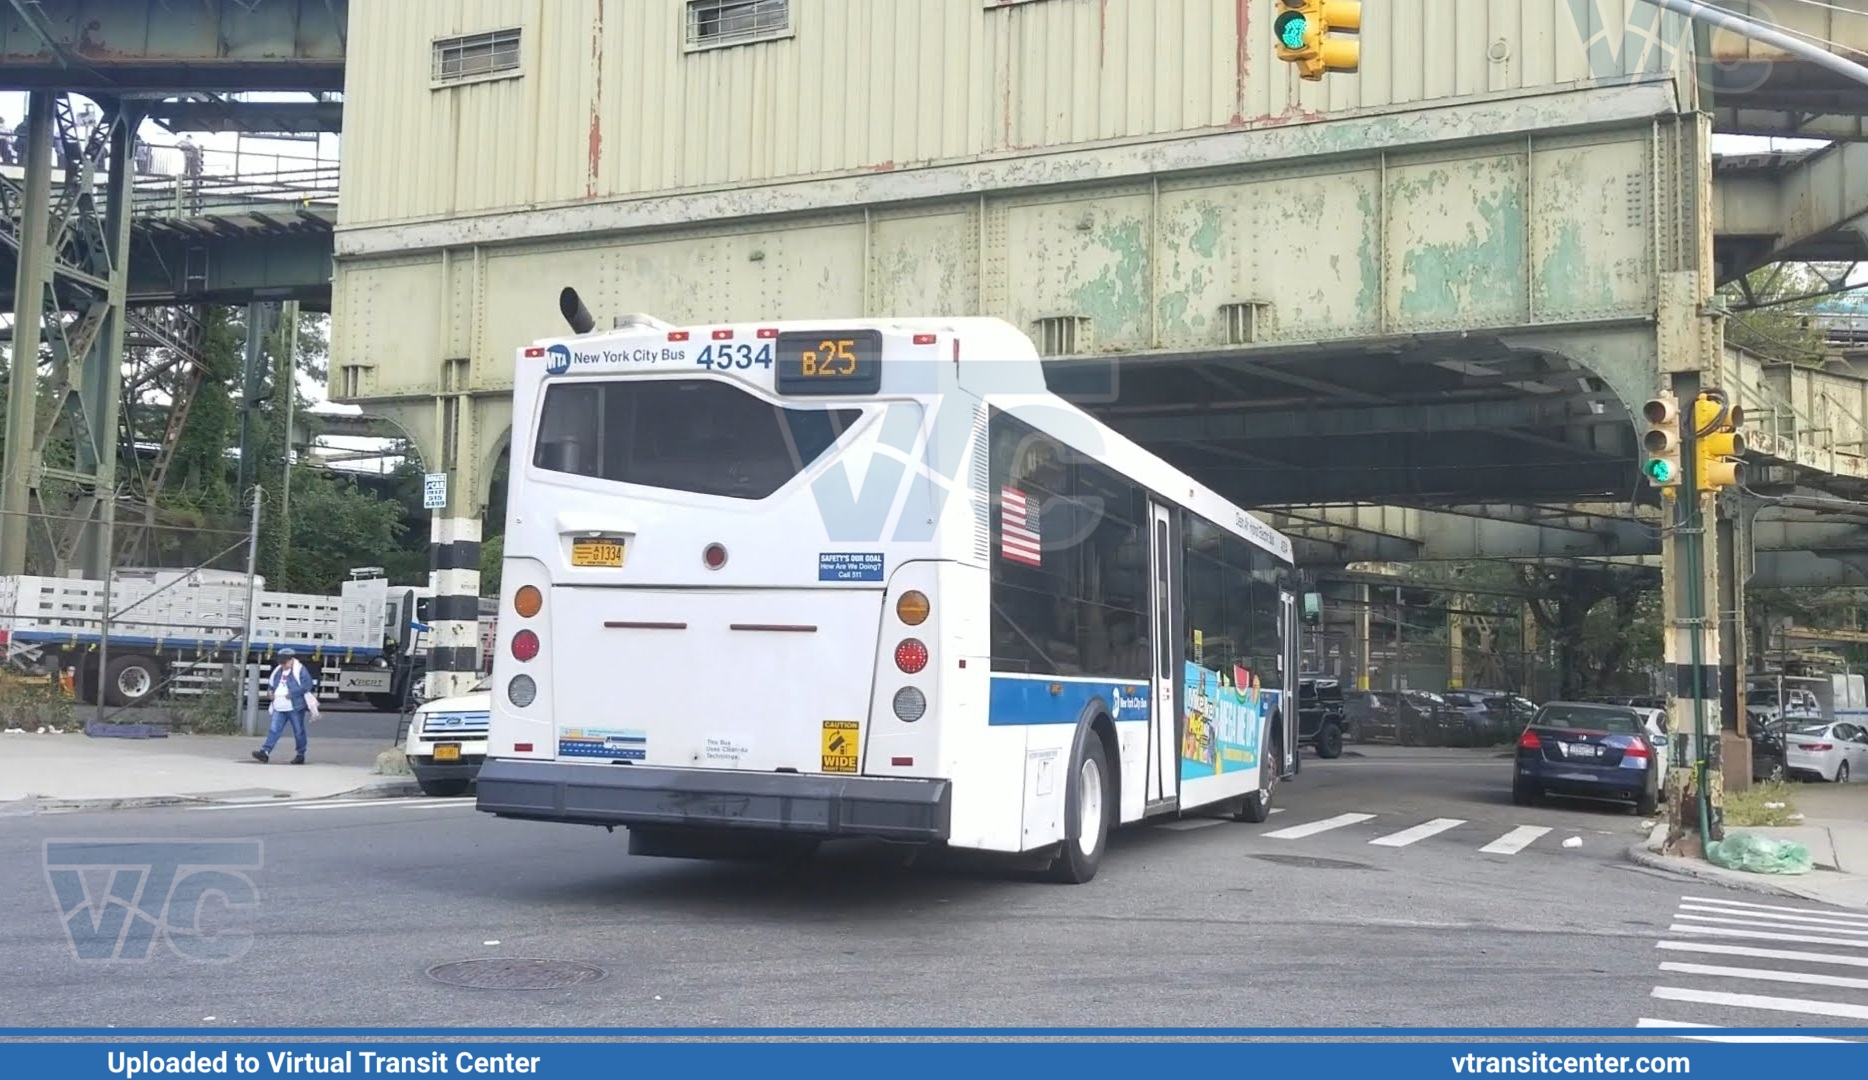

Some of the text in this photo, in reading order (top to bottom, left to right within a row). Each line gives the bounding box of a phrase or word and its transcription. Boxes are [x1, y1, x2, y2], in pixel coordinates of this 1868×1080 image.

[545, 346, 570, 373] MTA
[574, 348, 685, 363] New York City Bus
[696, 344, 772, 370] 4534
[802, 340, 856, 376] B25
[600, 546, 622, 561] 1334
[821, 554, 850, 562] SAFETY'S
[859, 563, 881, 571] Doing?
[824, 721, 858, 729] CAUTION
[823, 755, 857, 767] WIDE
